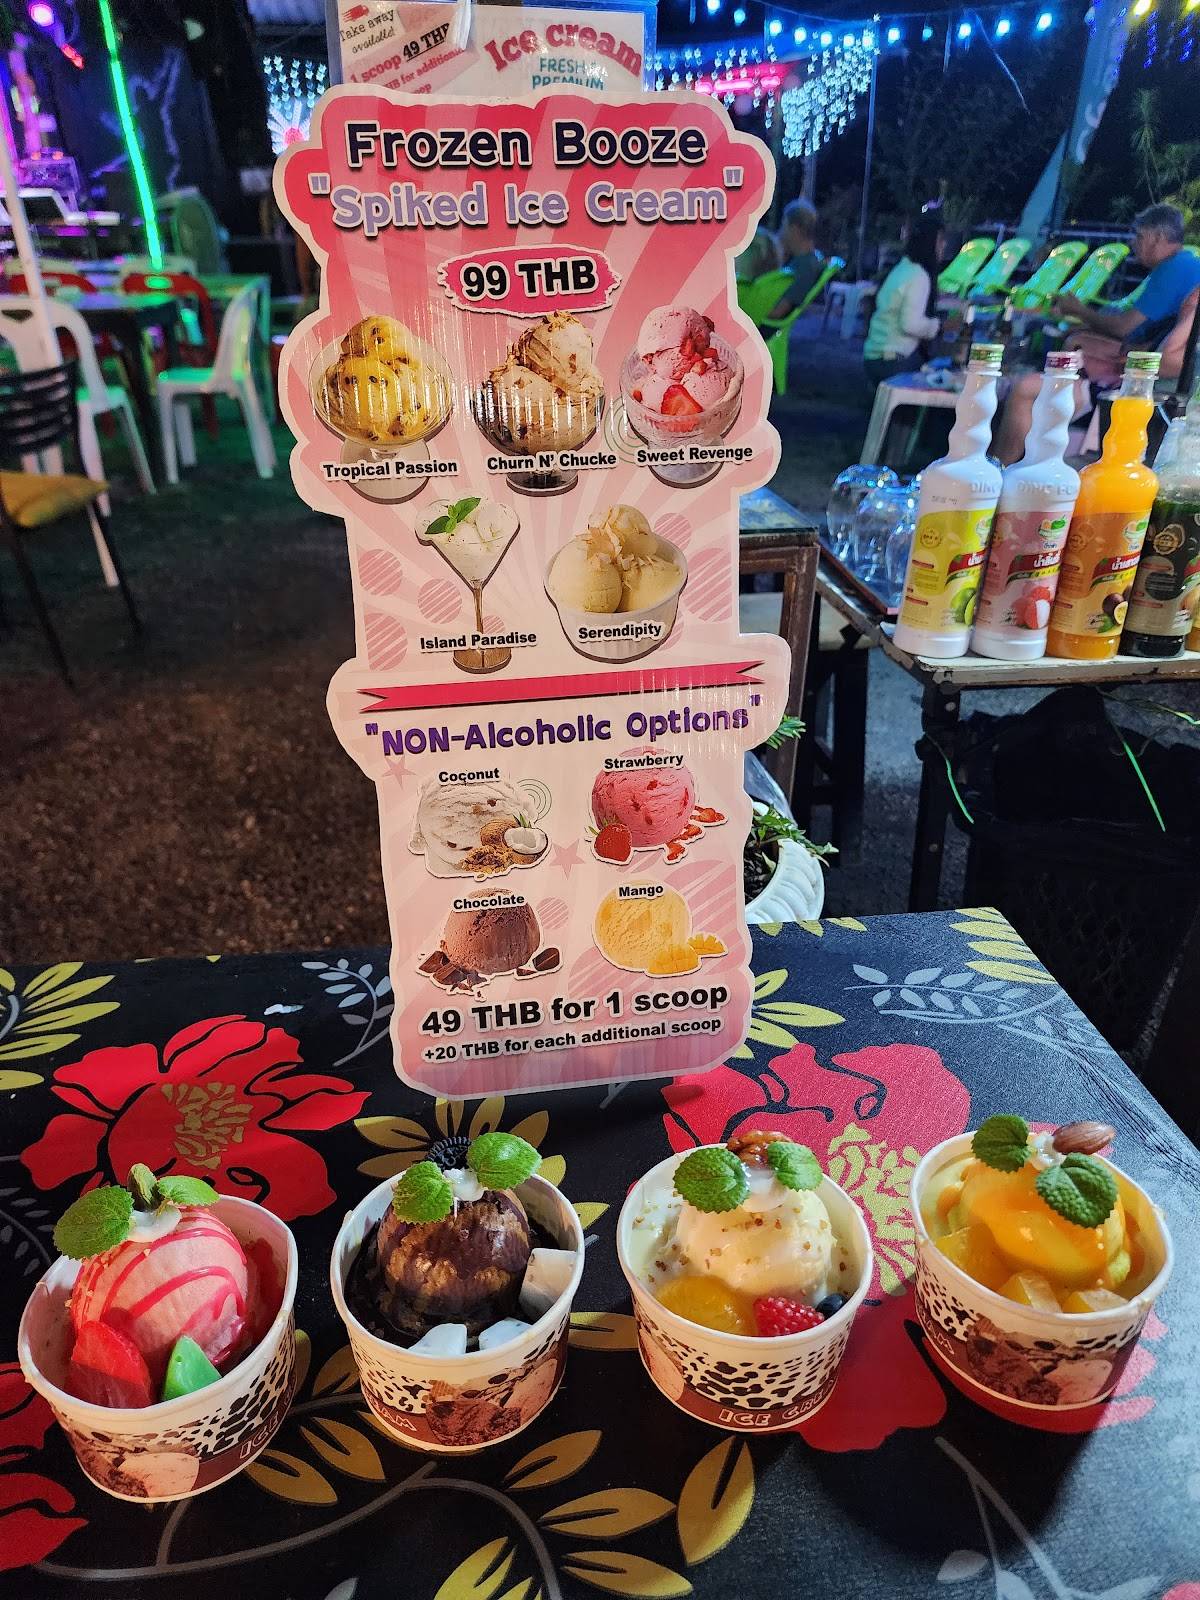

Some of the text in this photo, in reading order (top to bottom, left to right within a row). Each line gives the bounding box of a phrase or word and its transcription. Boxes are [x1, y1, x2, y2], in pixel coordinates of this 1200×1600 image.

[339, 9, 394, 42] Take away
[484, 24, 642, 77] Ice cream
[361, 54, 402, 83] scoop
[403, 40, 421, 59] 49
[539, 57, 586, 74] FRESH
[401, 69, 419, 84] for
[347, 121, 706, 165] Frozen Booze
[310, 167, 743, 234] "Spiked Ice Cream"
[463, 259, 597, 297] 99 THB
[487, 456, 534, 470] Churn
[559, 452, 617, 466] Chucke
[637, 446, 754, 462] Sweet Revenge
[323, 460, 458, 479] Tropical Passion
[420, 631, 537, 650] Island Paradise
[578, 624, 662, 640] Serendipity
[364, 694, 761, 757] "NON-Alcoholic Options"
[604, 753, 684, 770] Strawberry
[438, 767, 501, 783] Coconut
[618, 884, 664, 898] Mango
[453, 894, 525, 910] Chocolate
[422, 986, 728, 1034] 49 THB for 1 scoop
[424, 1019, 721, 1060] +20 THB for each additional scoop
[719, 1408, 772, 1427] ICE
